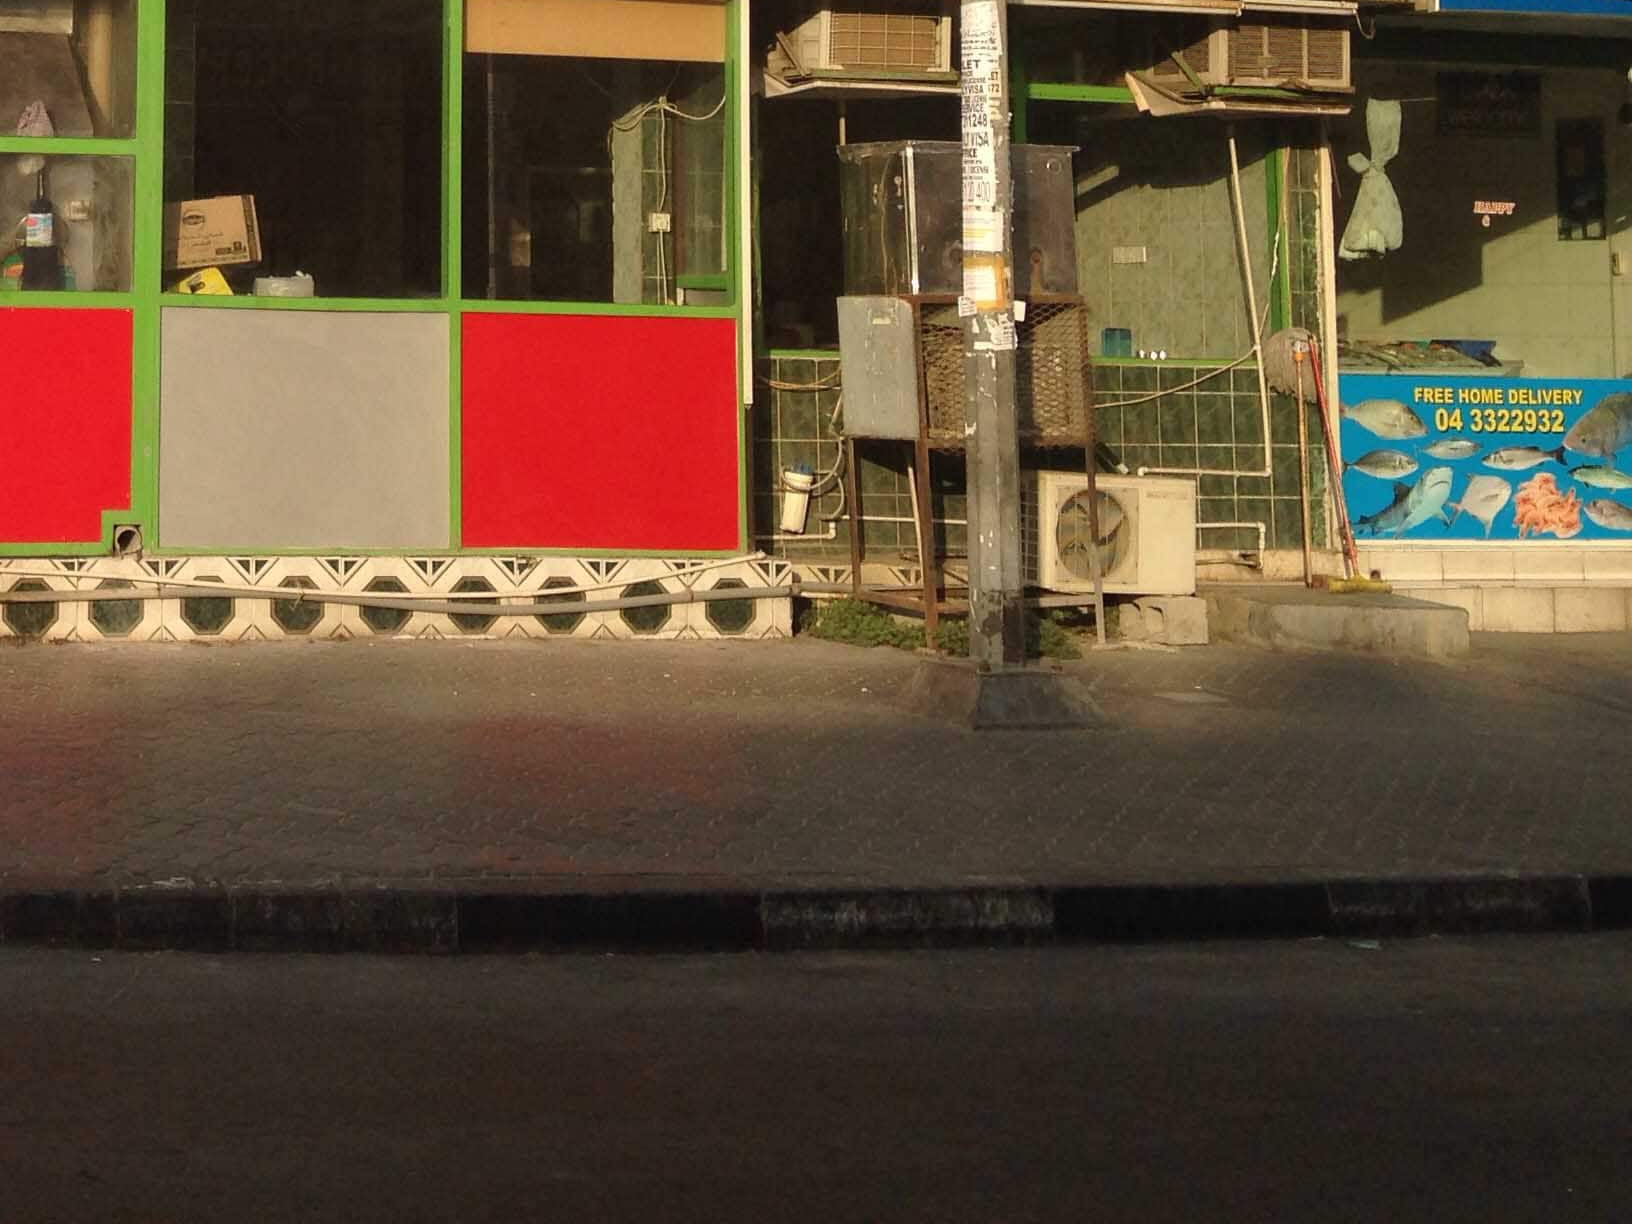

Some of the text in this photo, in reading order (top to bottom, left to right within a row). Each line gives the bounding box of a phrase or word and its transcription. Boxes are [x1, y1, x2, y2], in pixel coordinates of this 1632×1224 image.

[1414, 387, 1583, 406] FREE HOME DELIVERY
[1434, 407, 1566, 433] 04 3322932
